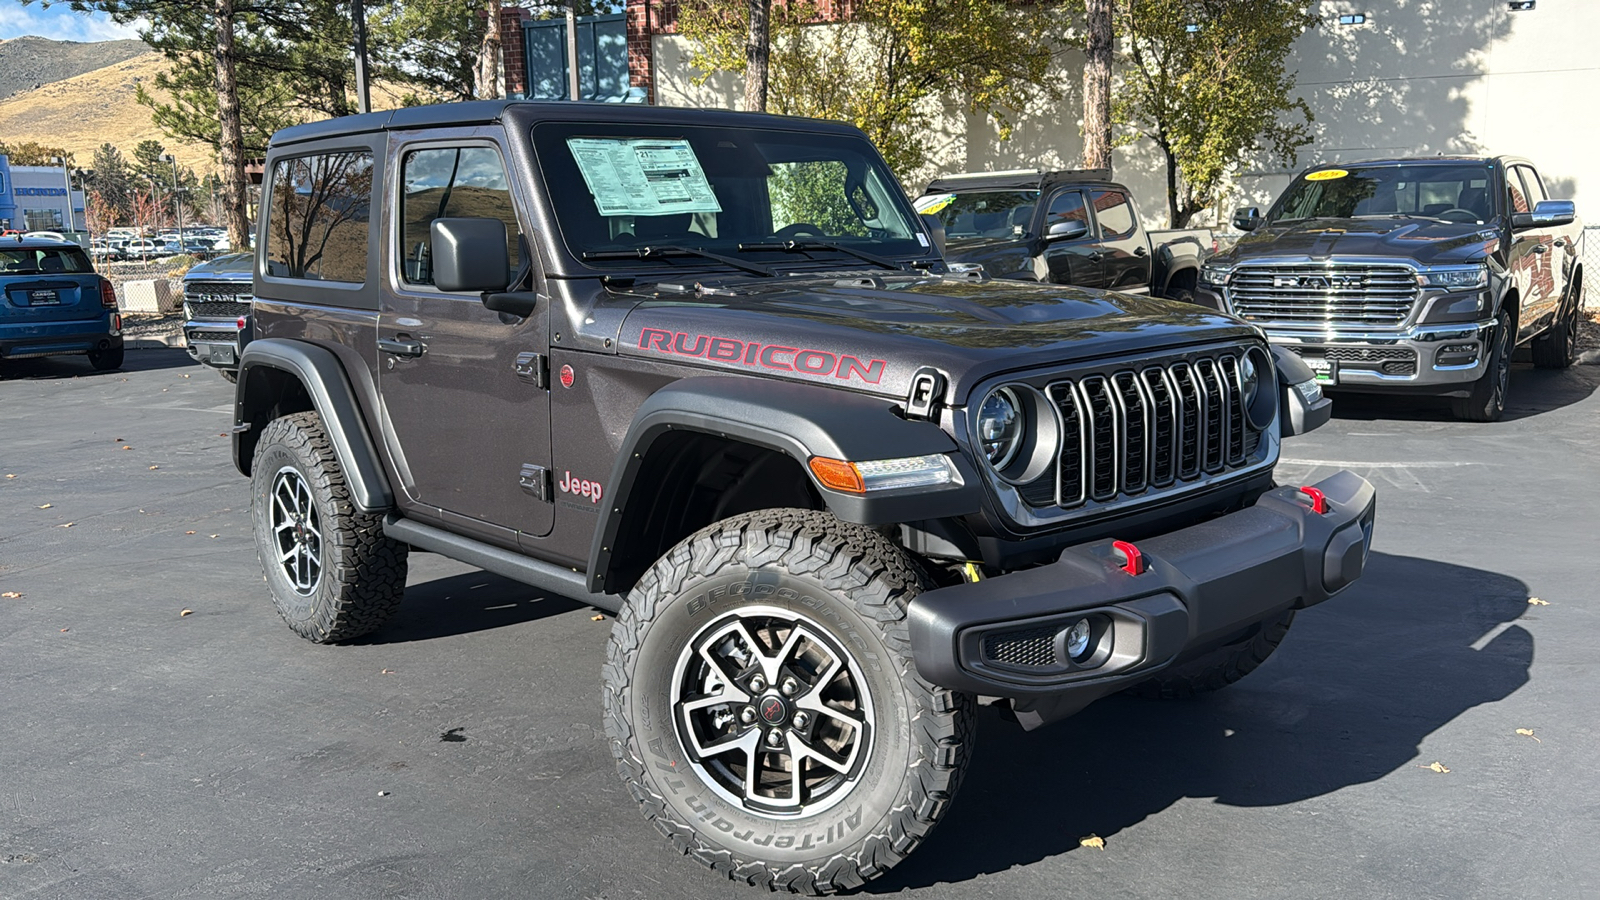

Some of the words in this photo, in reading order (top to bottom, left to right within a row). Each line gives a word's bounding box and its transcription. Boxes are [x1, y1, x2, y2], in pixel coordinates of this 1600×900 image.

[14, 187, 68, 196] HONDA
[199, 294, 235, 302] RAM
[1274, 276, 1361, 288] RAM
[637, 327, 887, 384] RUBICON
[559, 470, 603, 504] Jeep
[686, 580, 883, 673] BFGoodrich
[684, 795, 864, 852] All-Terrain
